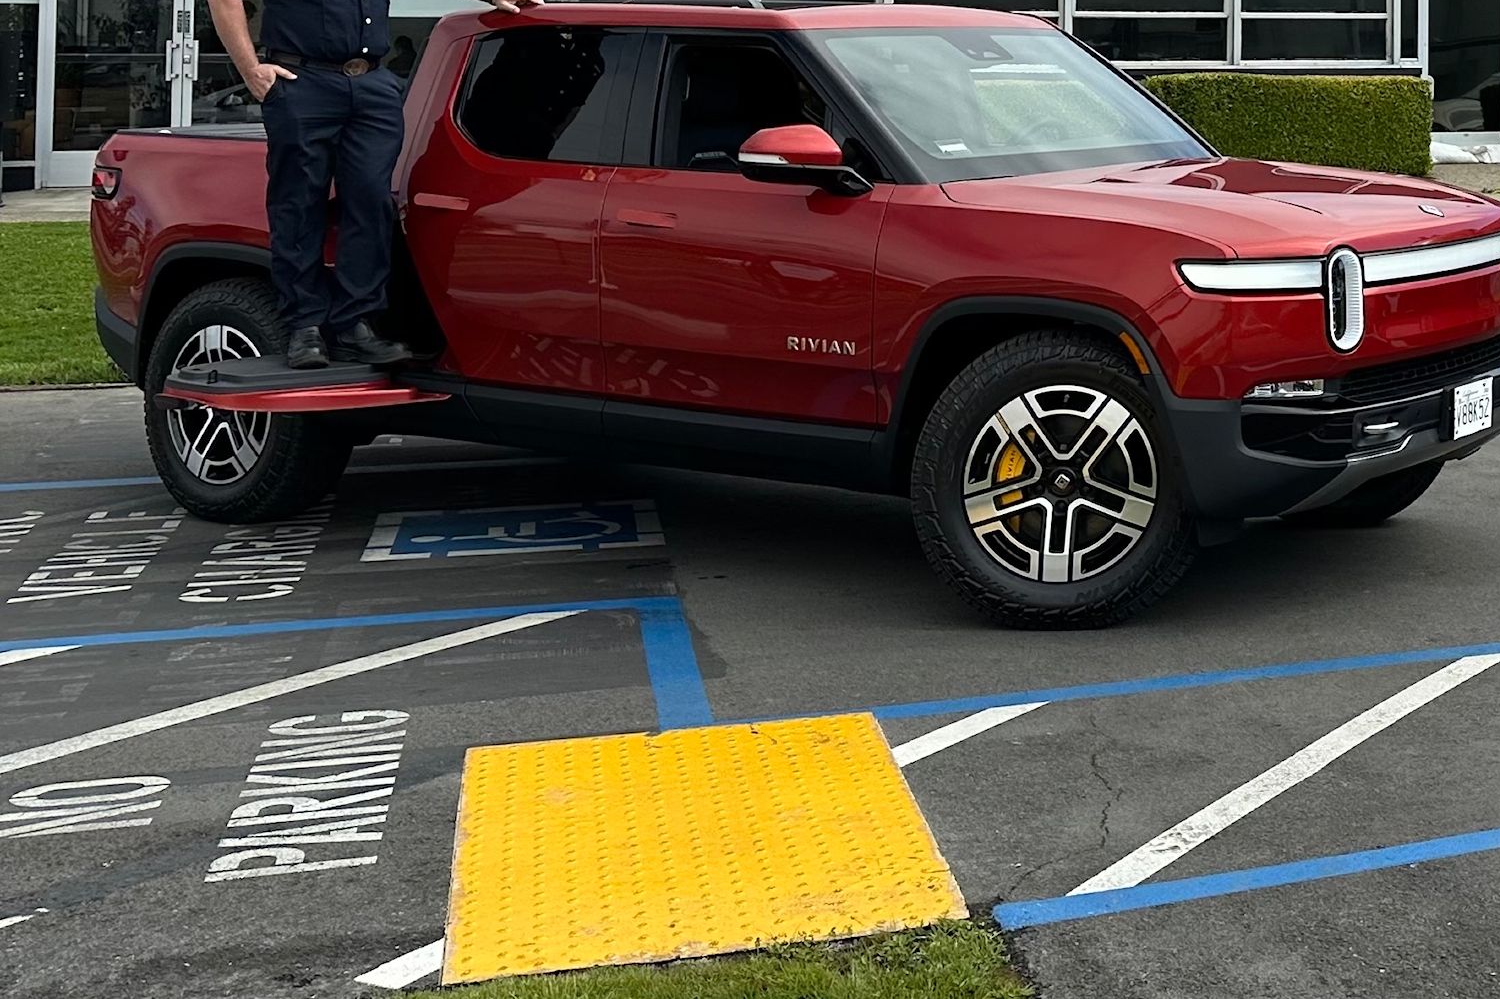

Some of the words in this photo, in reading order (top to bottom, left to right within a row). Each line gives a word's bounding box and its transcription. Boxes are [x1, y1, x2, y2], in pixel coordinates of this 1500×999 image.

[787, 336, 856, 356] RIVIAN
[1455, 397, 1490, 427] V88K52
[1006, 450, 1017, 478] IVIAN
[7, 506, 189, 604] VEHICLE
[0, 775, 171, 838] NO
[204, 710, 410, 883] PARKING
